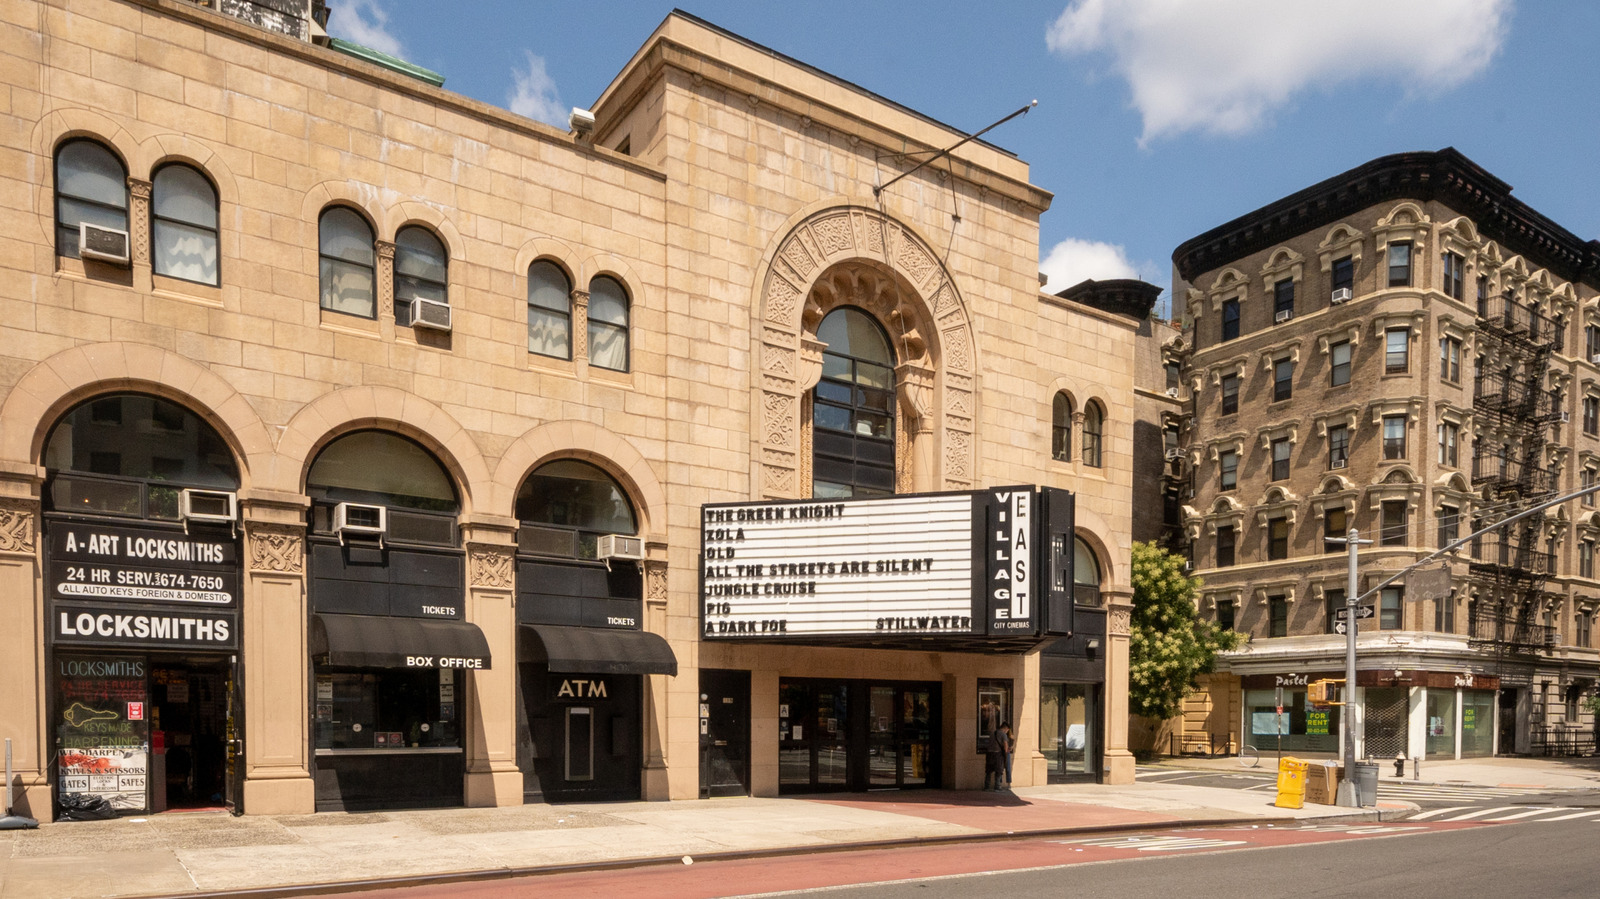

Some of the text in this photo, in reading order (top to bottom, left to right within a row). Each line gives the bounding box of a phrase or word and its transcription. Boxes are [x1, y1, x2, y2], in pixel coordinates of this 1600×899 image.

[706, 504, 844, 522] THE GREEN KNIGHT
[706, 528, 745, 540] ZOLA
[127, 537, 224, 562] LOCKSMITHS
[706, 547, 735, 559] OLD
[994, 492, 1010, 618] VILLAGE
[1016, 496, 1026, 614] EAST
[706, 558, 933, 578] ALL THE STREETS ARE SILENT
[66, 567, 86, 582] 24
[92, 570, 110, 583] HR
[160, 574, 224, 590] 674-7650
[82, 586, 108, 594] AUTO
[110, 588, 134, 596] KEYS
[136, 590, 174, 598] FOREIGN
[185, 592, 228, 601] DOMESTIC
[706, 582, 816, 596] JUNGLE CRUISE
[422, 606, 456, 615] TICKETS
[706, 602, 730, 614] PIG
[61, 612, 229, 641] LOCKSMITHS
[608, 617, 634, 626] TICKETS
[706, 620, 786, 632] A DARK FOE
[876, 616, 970, 630] STILLWATER
[61, 661, 144, 676] LOCKSMITHS
[406, 656, 482, 668] BOX OFFICE
[98, 680, 144, 690] SERVICE
[1276, 675, 1308, 686] Pastel
[558, 680, 607, 698] ATM
[84, 722, 132, 732] KEYS MADE
[61, 780, 86, 788] GATES
[121, 778, 144, 787] SAFES
